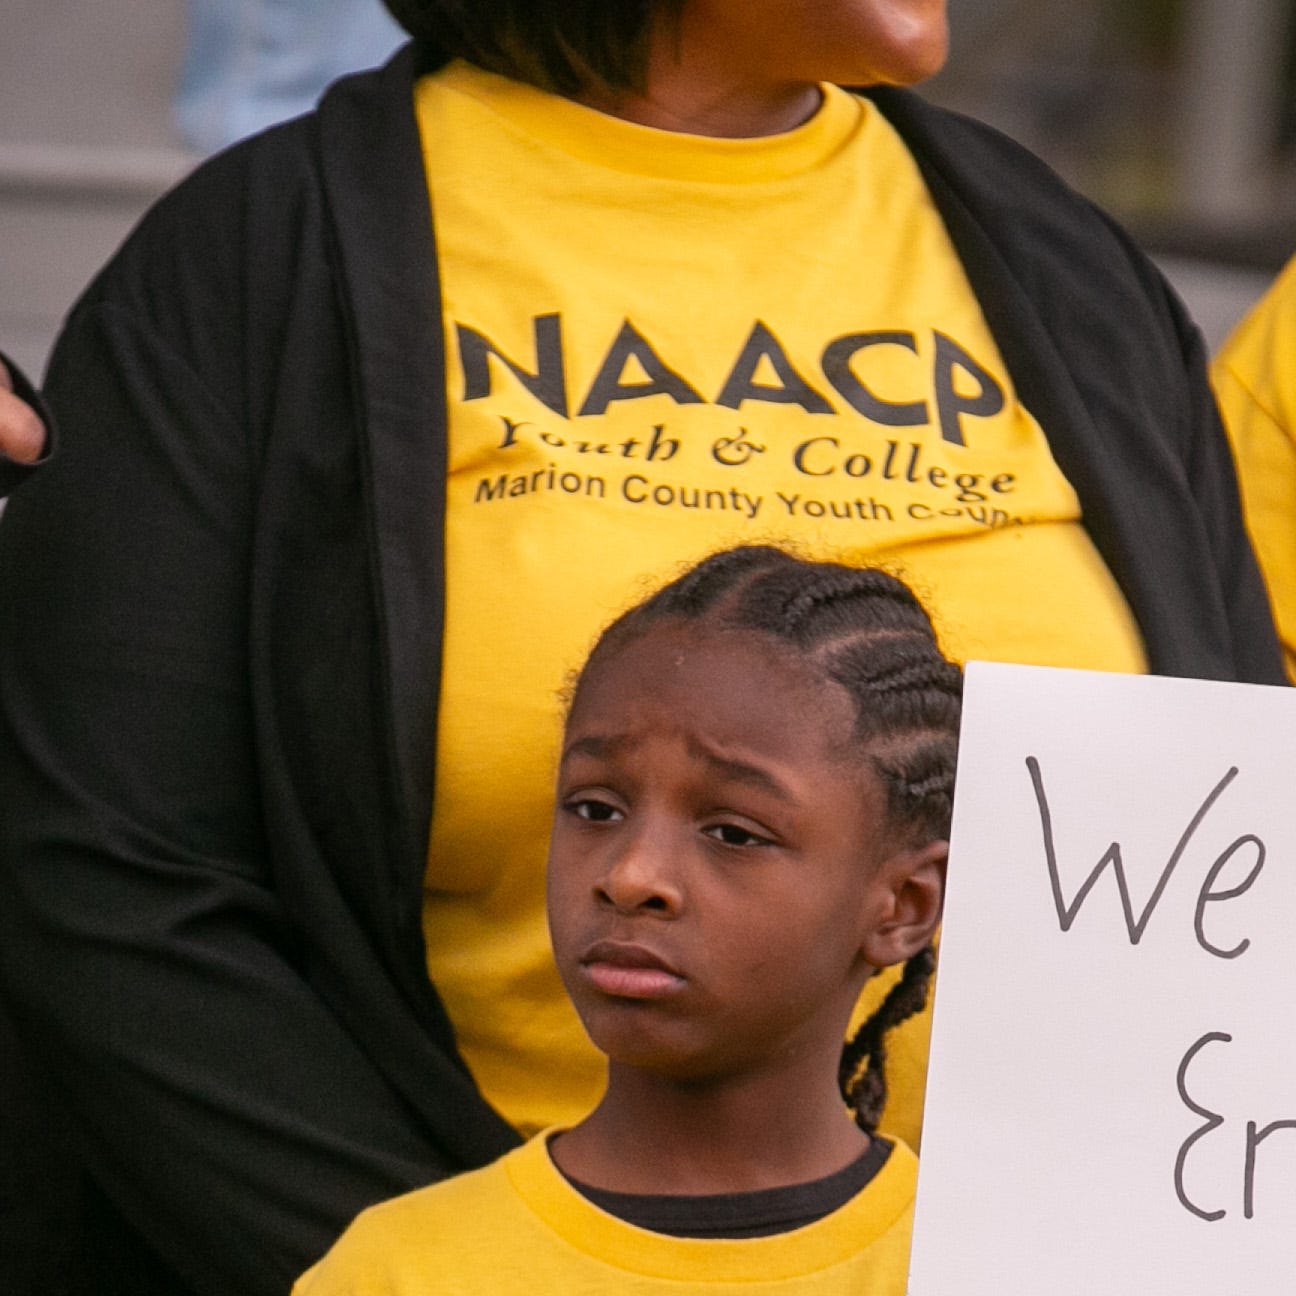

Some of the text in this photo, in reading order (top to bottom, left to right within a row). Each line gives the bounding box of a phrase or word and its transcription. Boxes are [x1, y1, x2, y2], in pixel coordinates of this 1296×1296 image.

[453, 311, 1006, 446] NAACP
[474, 462, 606, 503] Marion
[622, 474, 764, 520] County
[777, 490, 895, 522] Youth
[499, 415, 1018, 503] Youth & College
[1025, 755, 1267, 960] We
